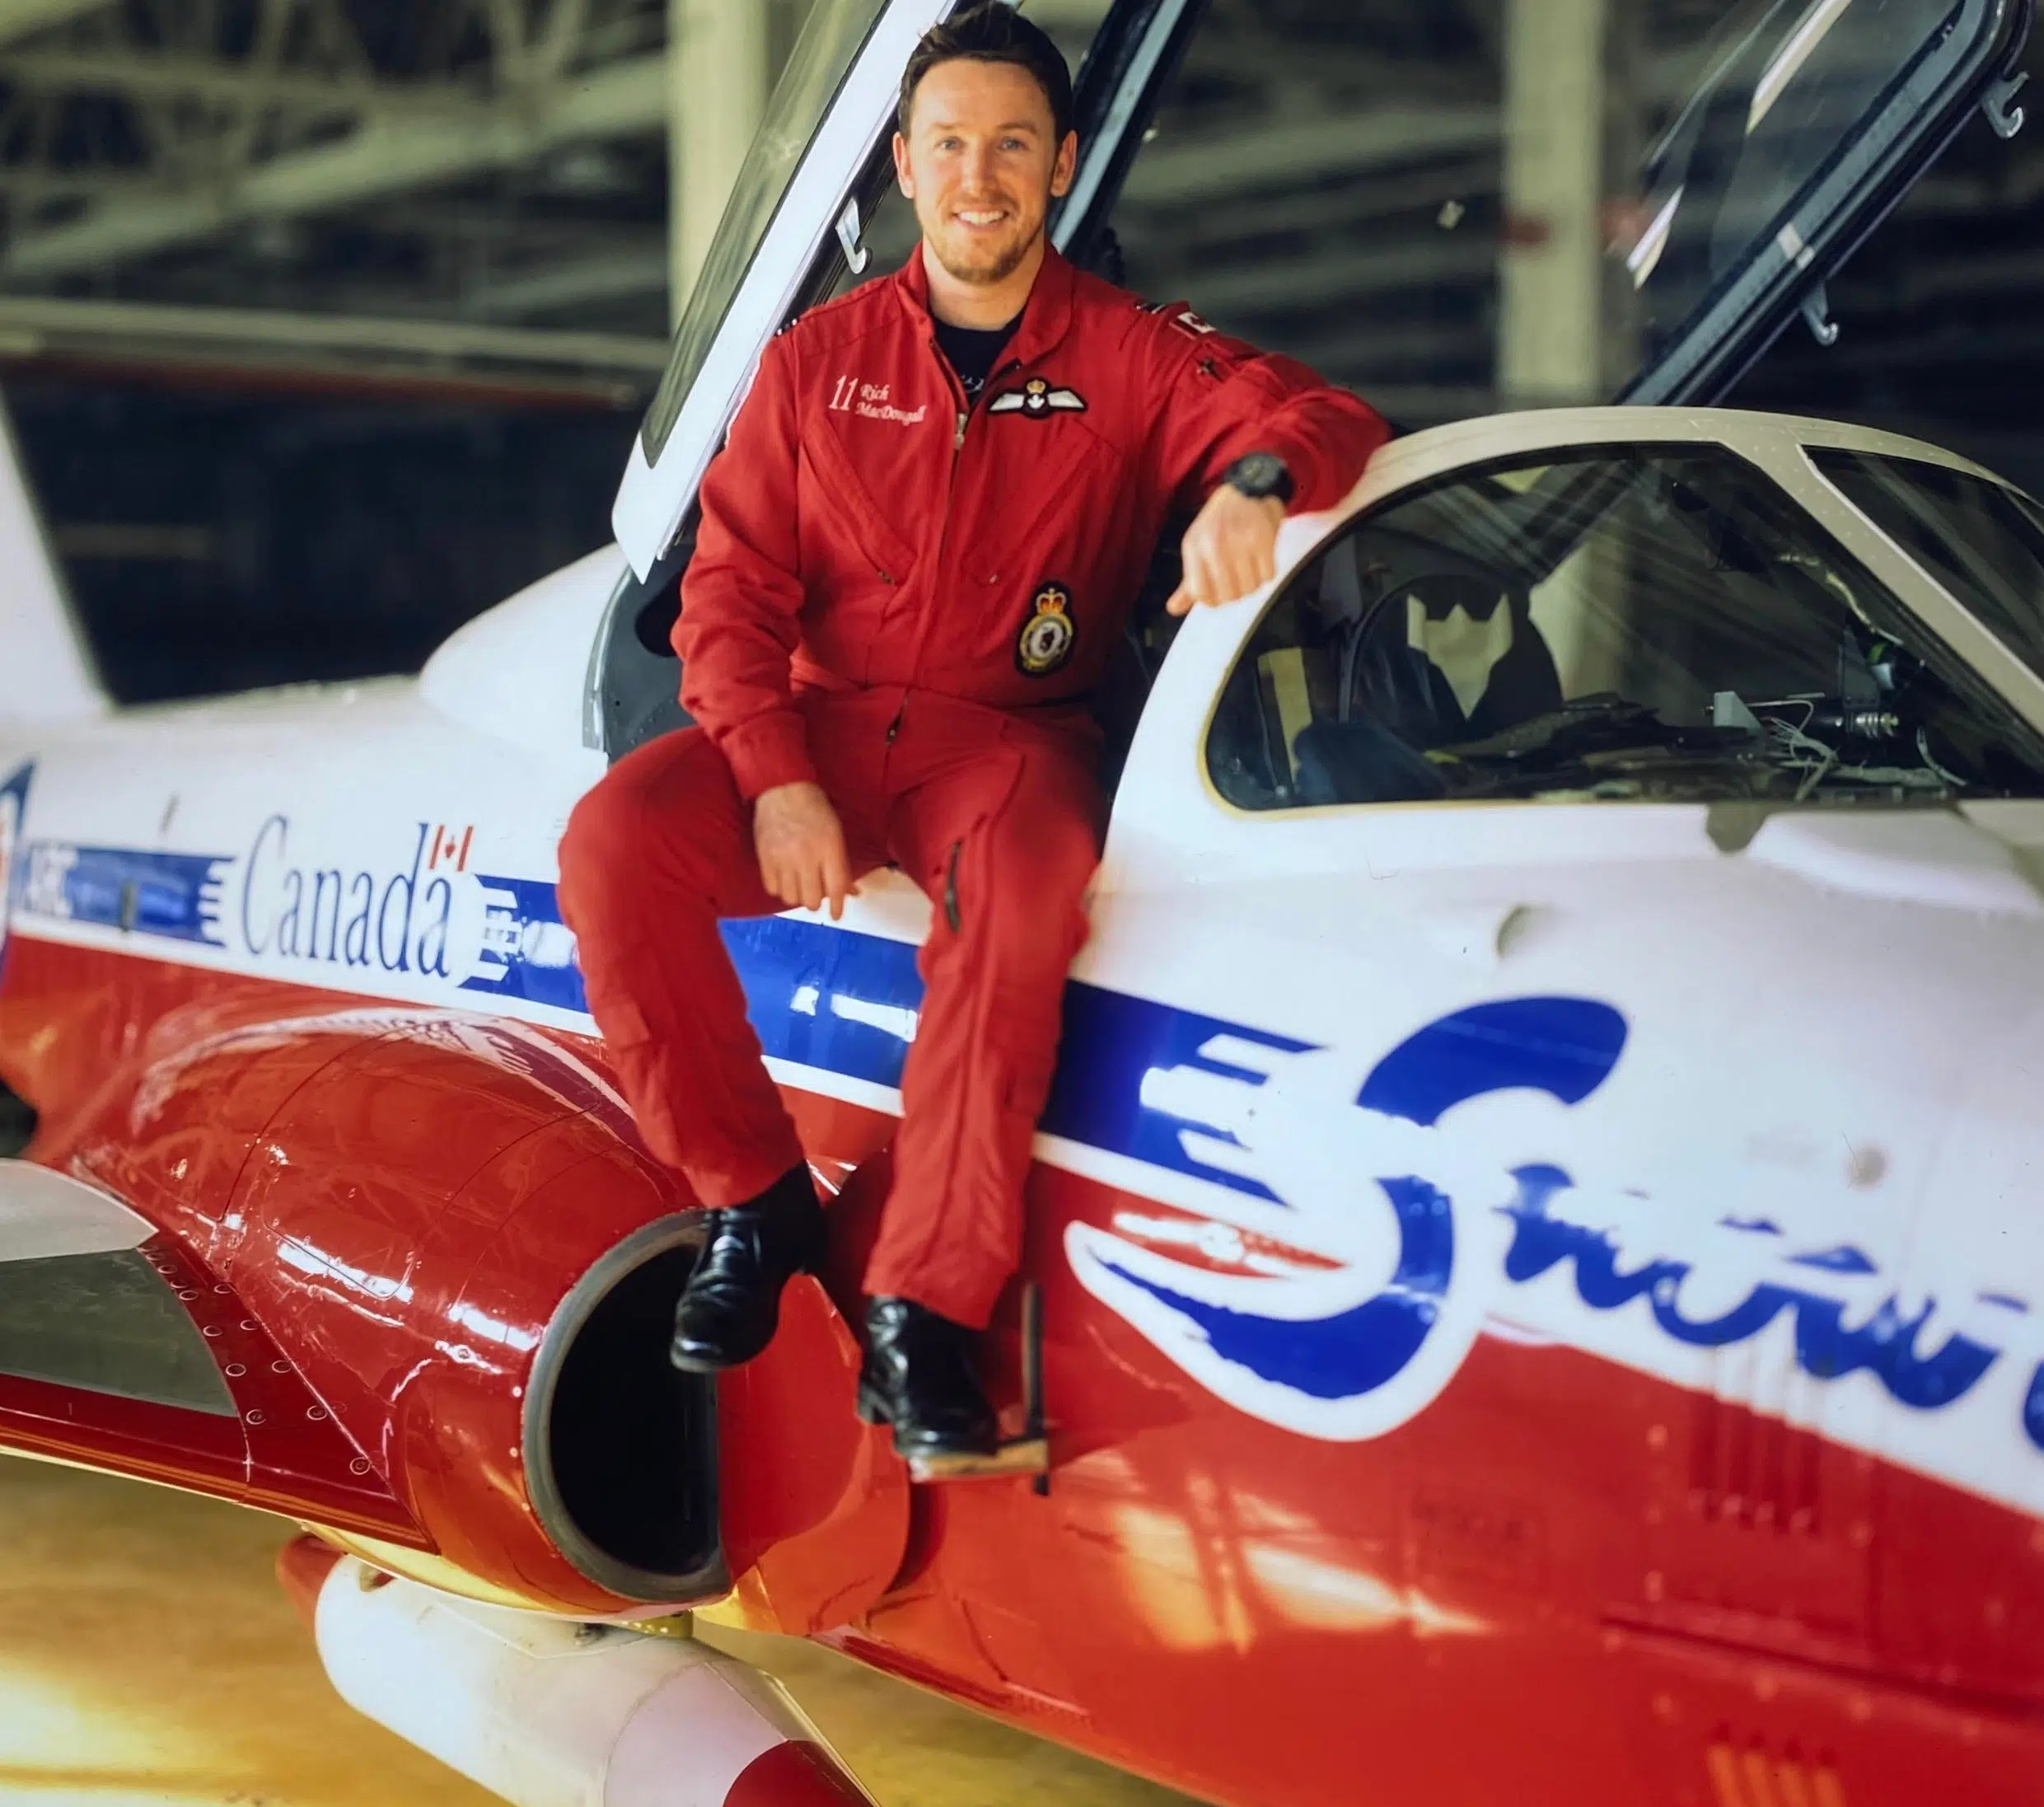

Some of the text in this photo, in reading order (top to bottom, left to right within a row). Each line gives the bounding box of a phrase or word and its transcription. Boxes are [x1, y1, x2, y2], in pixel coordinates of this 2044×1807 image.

[828, 374, 858, 411] 11
[860, 383, 890, 401] Rich
[241, 814, 452, 978] Canada
[1086, 995, 2044, 1457] Snow
